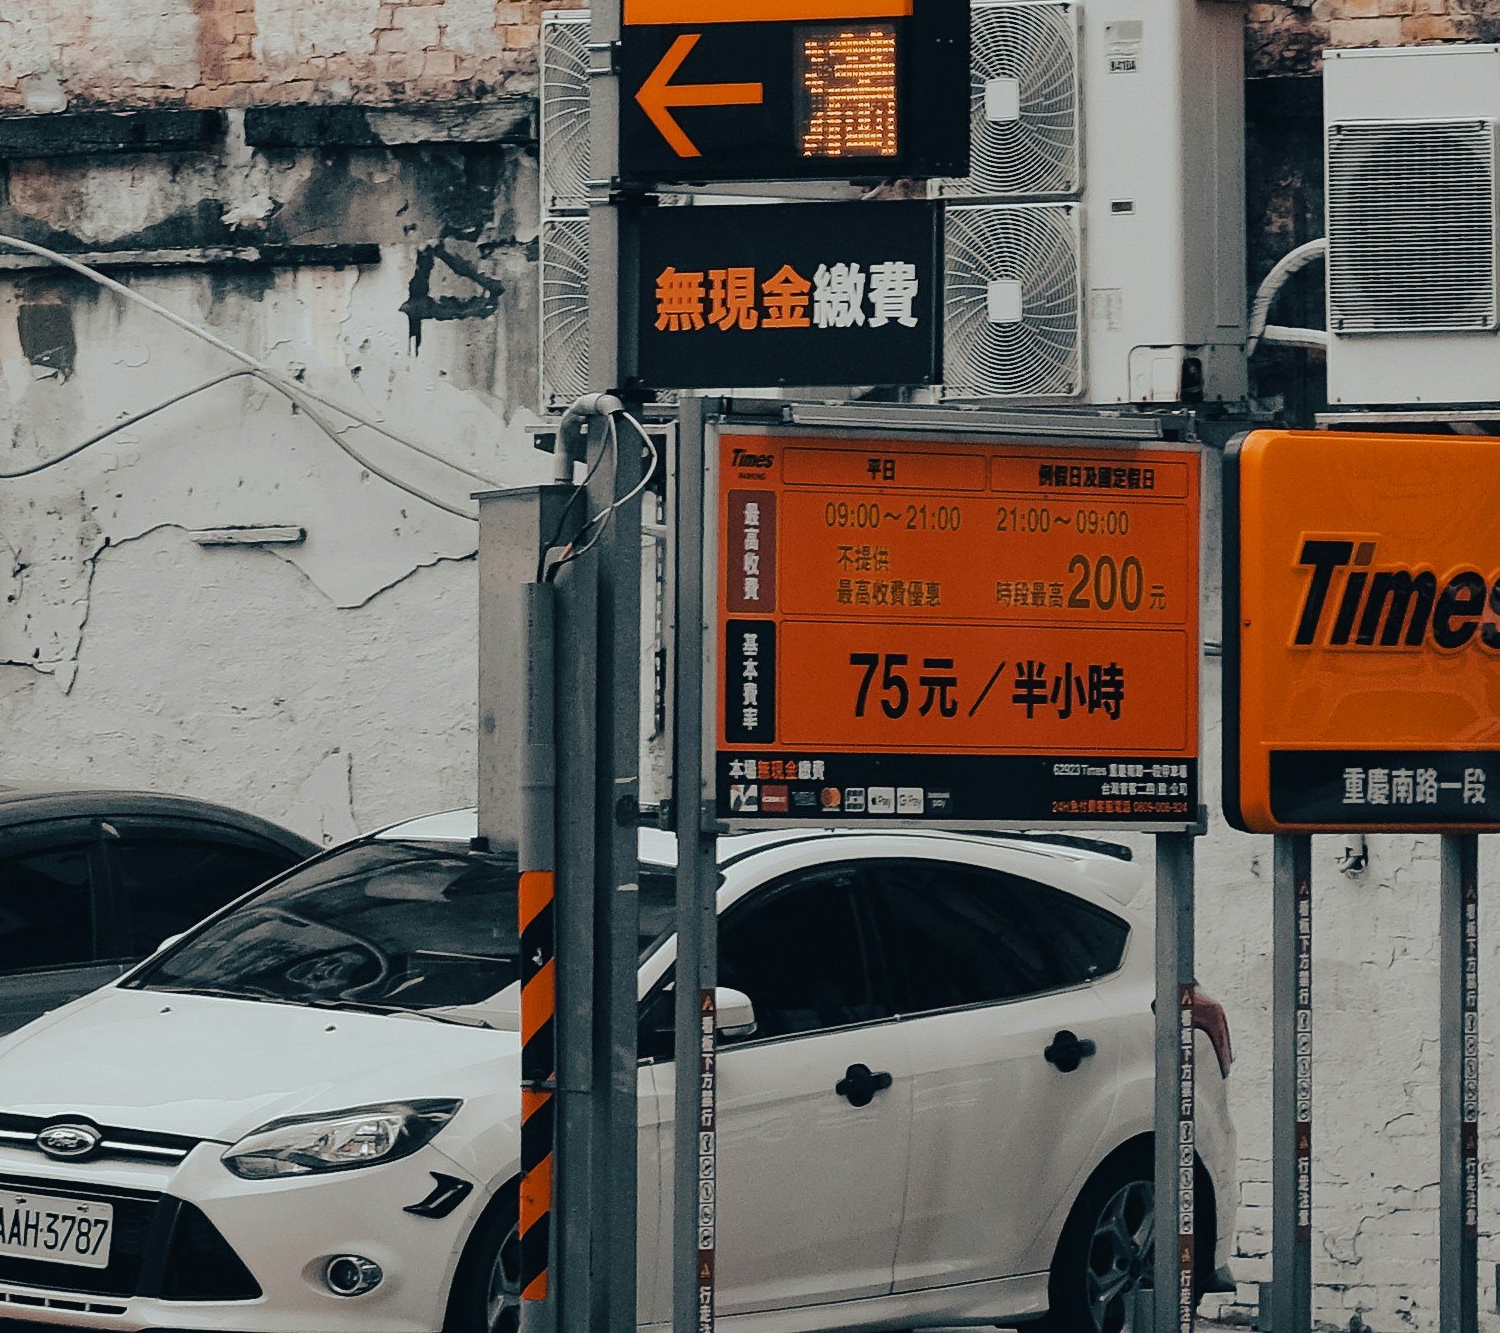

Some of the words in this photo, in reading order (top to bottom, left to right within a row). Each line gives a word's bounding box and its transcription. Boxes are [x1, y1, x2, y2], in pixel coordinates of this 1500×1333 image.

[655, 261, 919, 333] 無現金繳費
[731, 448, 774, 468] Times
[867, 458, 896, 481] 平日
[742, 501, 761, 601] 最高收費
[1342, 767, 1486, 805] 重慶南路一段
